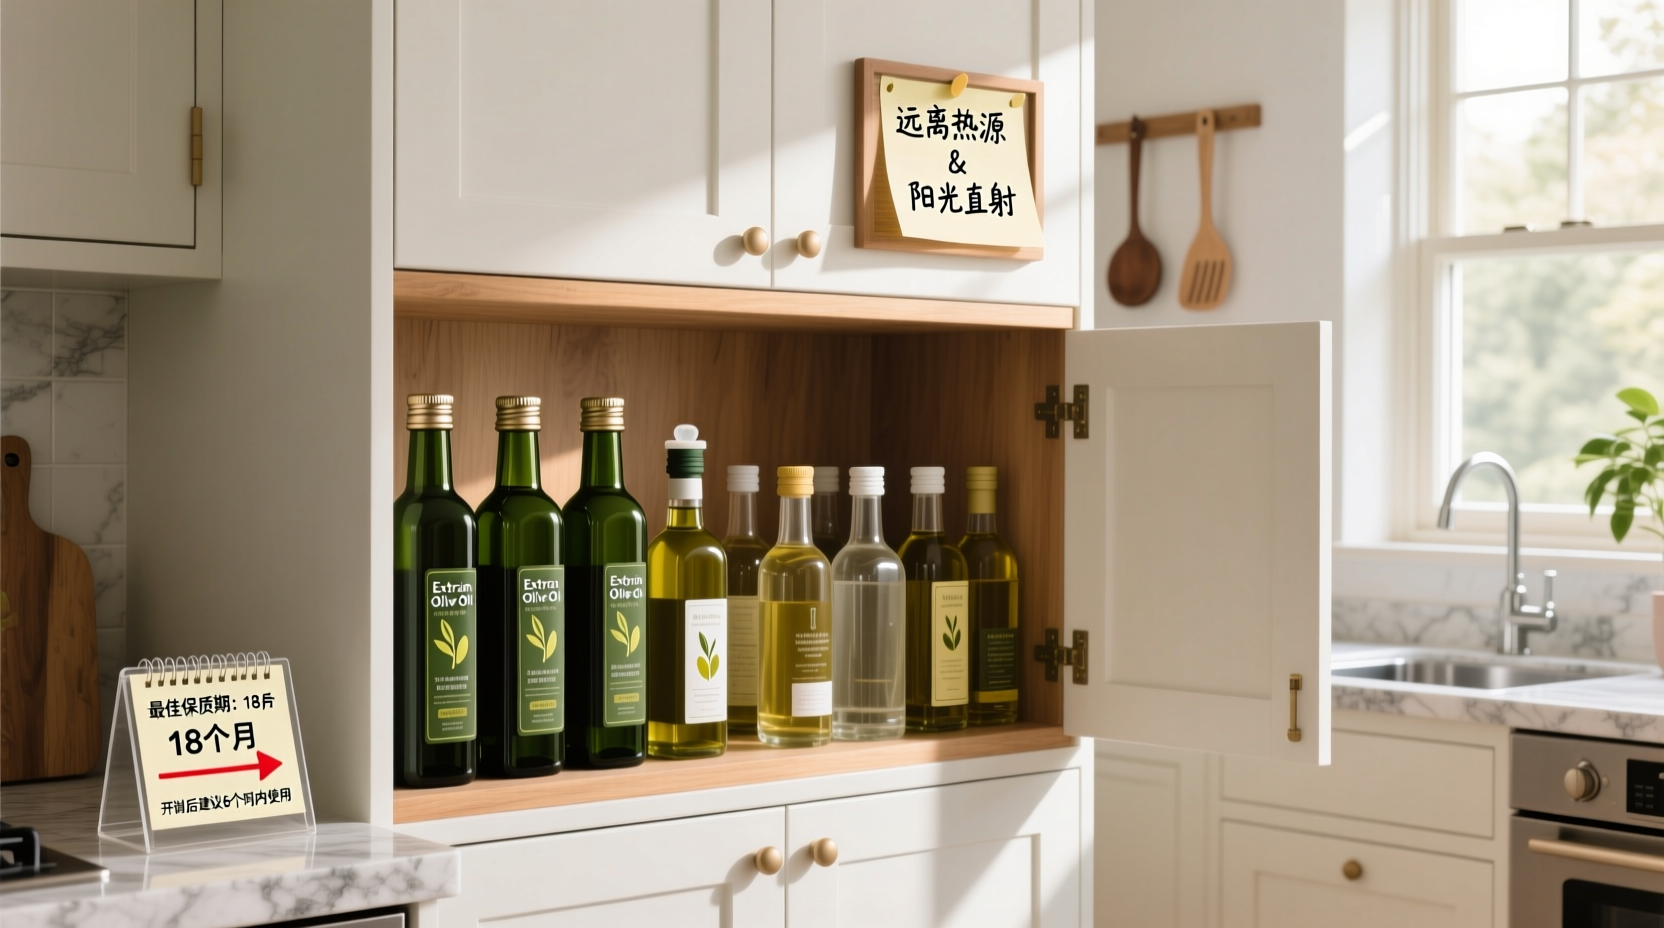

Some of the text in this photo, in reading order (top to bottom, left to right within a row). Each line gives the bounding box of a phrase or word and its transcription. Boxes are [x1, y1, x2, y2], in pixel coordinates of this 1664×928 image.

[896, 104, 1006, 144] 远离热源
[948, 149, 967, 174] &
[908, 181, 1017, 217] 阳光直射
[168, 721, 255, 756] 18个月
